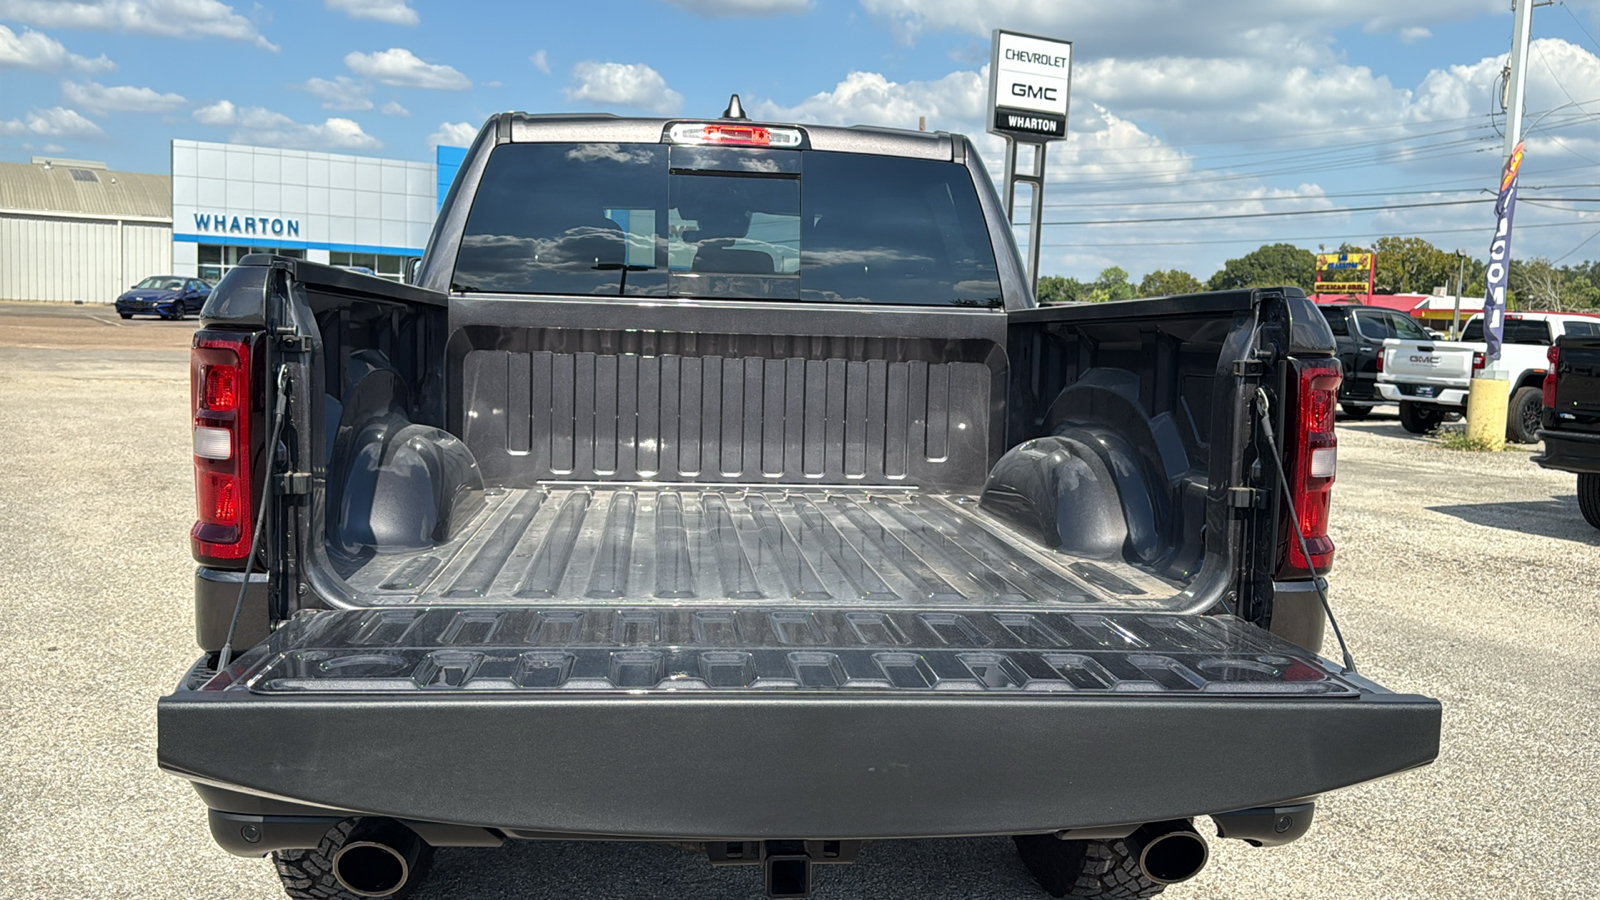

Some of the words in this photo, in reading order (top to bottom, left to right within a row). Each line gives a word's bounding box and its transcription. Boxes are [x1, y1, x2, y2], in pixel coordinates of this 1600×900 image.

[1005, 48, 1067, 68] CHEVROLET
[1011, 82, 1057, 102] GMC
[1008, 115, 1057, 132] WHARTON
[194, 213, 299, 237] WHARTON
[1409, 355, 1440, 364] GMC
